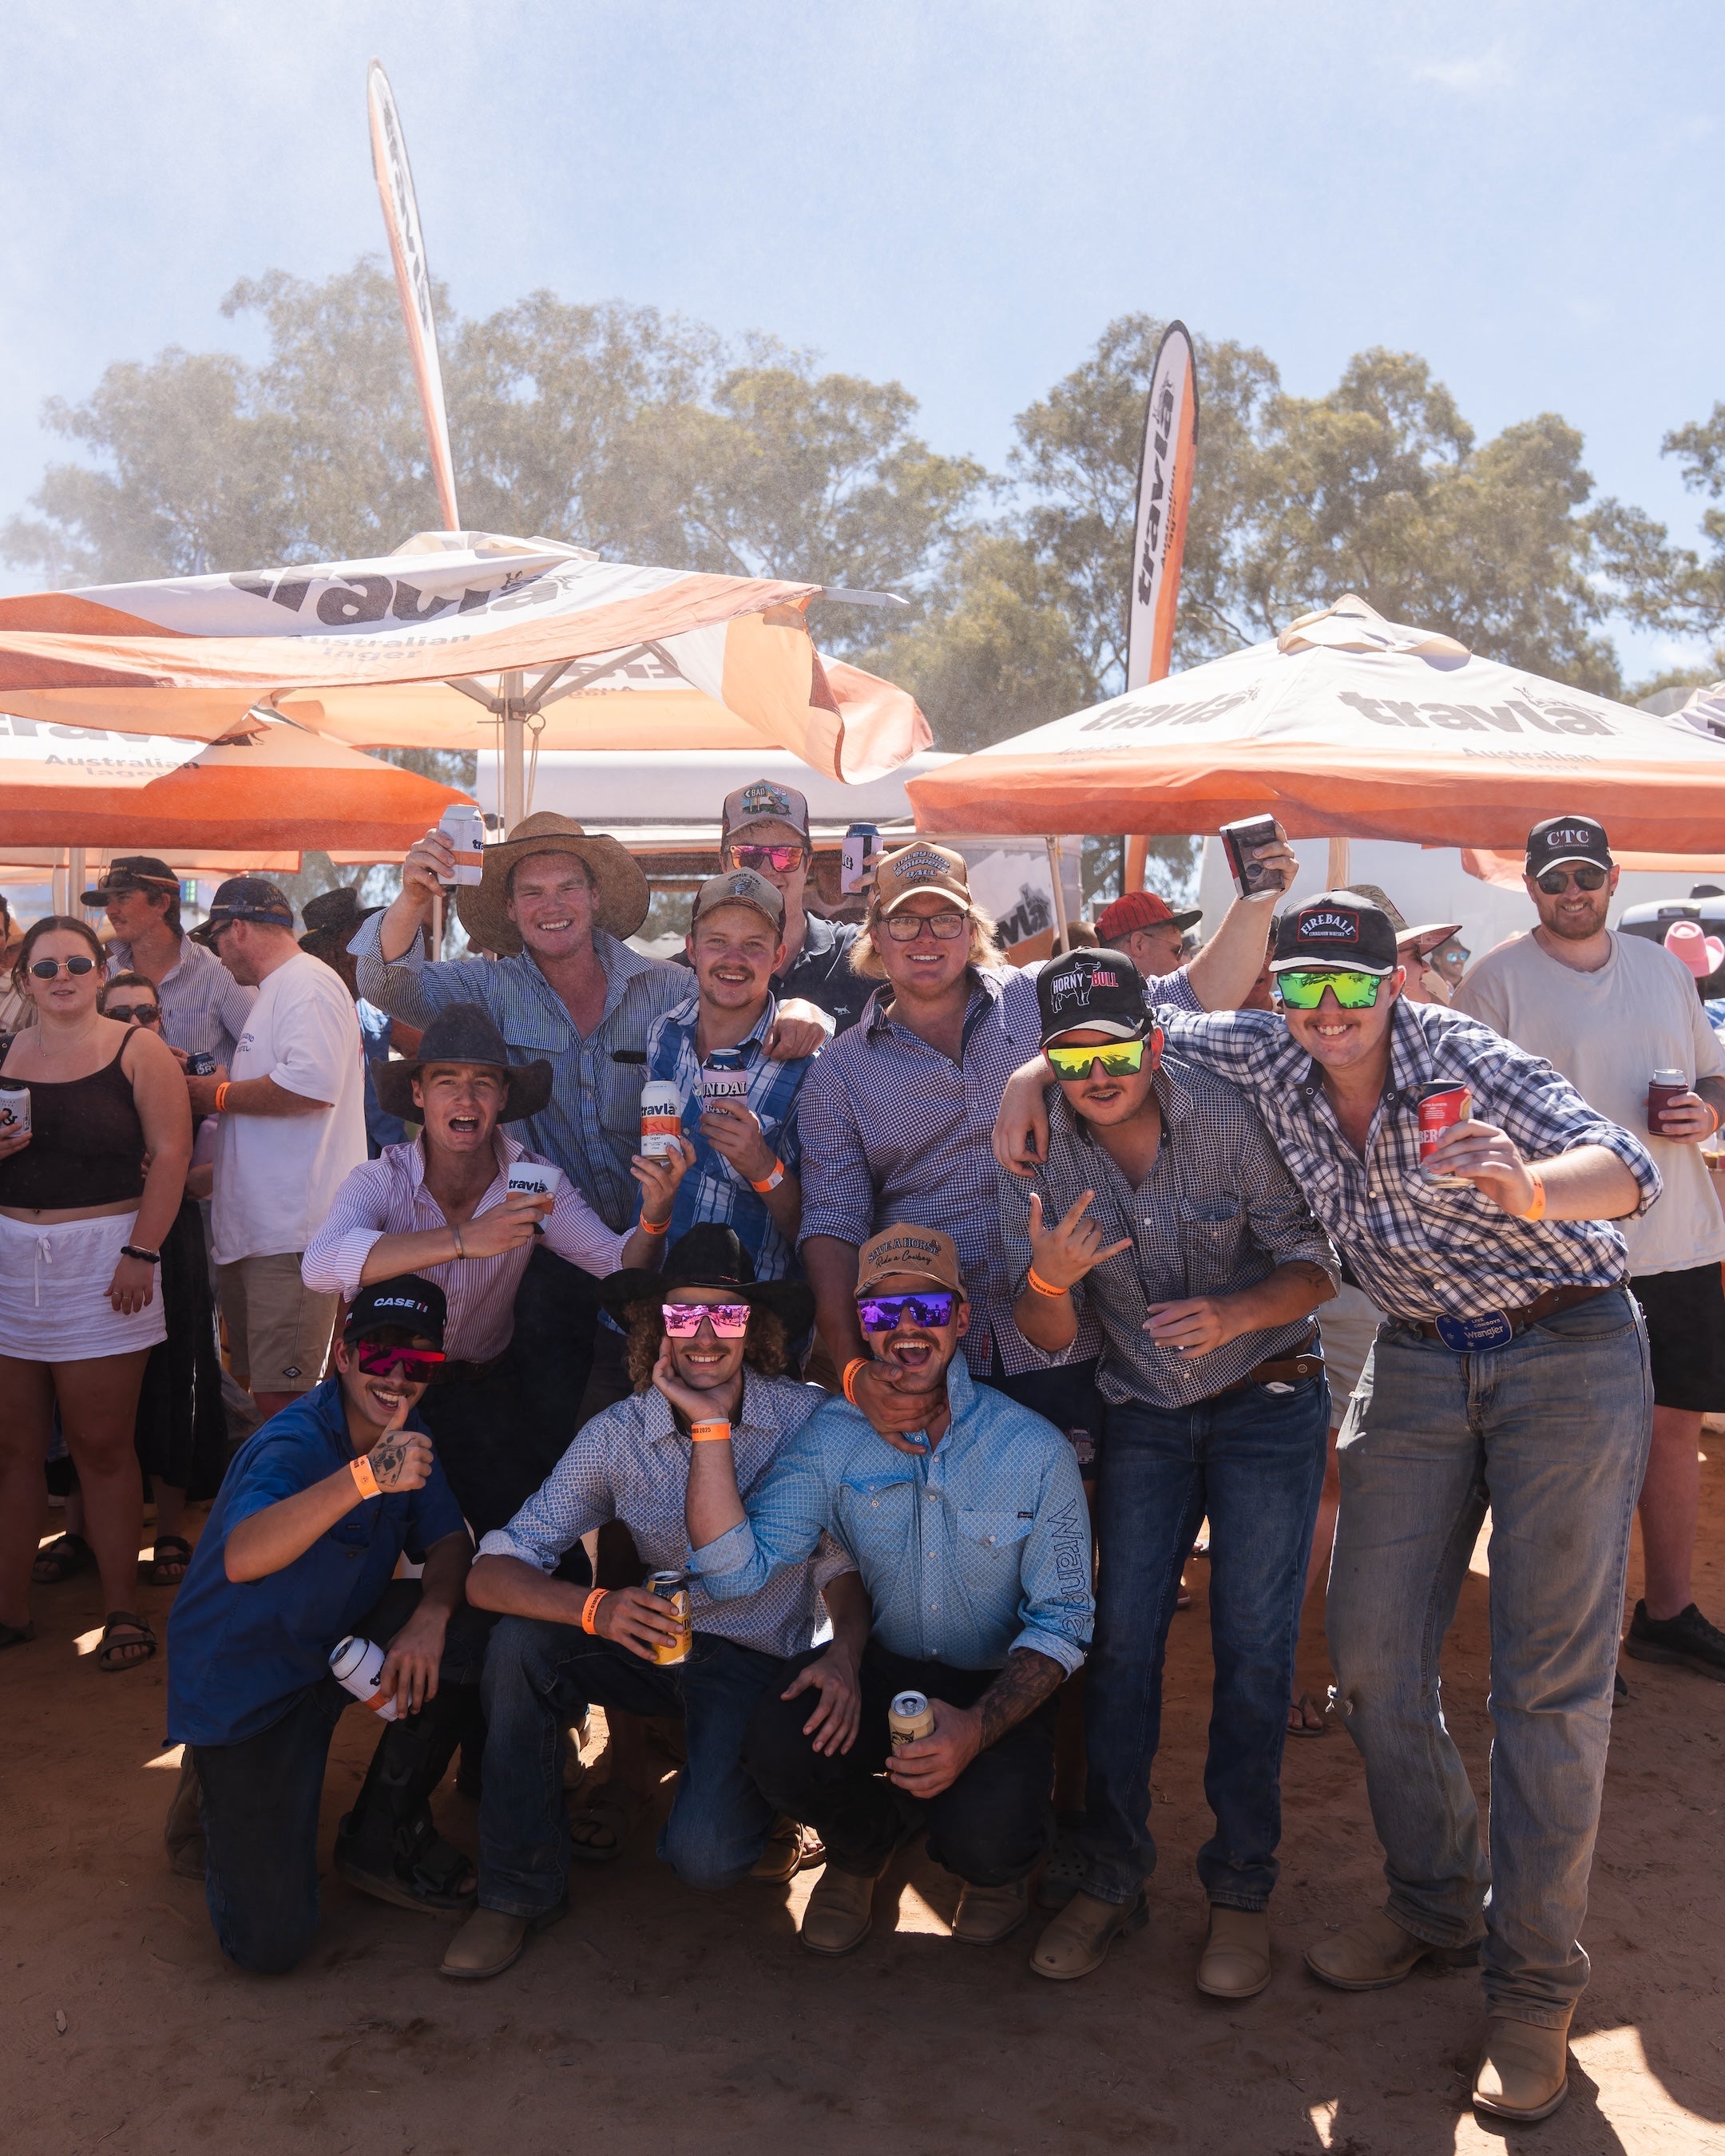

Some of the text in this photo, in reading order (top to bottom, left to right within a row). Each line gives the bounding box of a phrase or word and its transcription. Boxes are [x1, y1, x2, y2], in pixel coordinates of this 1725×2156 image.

[1138, 389, 1174, 607] travla
[1080, 693, 1246, 731] travla
[1336, 691, 1616, 736] travla
[751, 787, 765, 797] BAD
[1547, 830, 1589, 846] CTC
[893, 851, 950, 871] FINLEY RICE
[895, 858, 948, 877] STRIPPERS
[906, 868, 937, 878] BALL
[1300, 914, 1356, 935] FIREBALL
[1053, 972, 1120, 995] HORNY BULL
[509, 1179, 545, 1194] travla
[868, 1238, 940, 1263] SAVE A HORSE
[876, 1254, 892, 1269] Ride
[902, 1249, 932, 1266] Cowboy
[374, 1297, 415, 1309] CASE
[1464, 1326, 1503, 1339] Wrangler
[1473, 1318, 1501, 1328] COWBOYS
[1047, 1498, 1093, 1638] Wrangle
